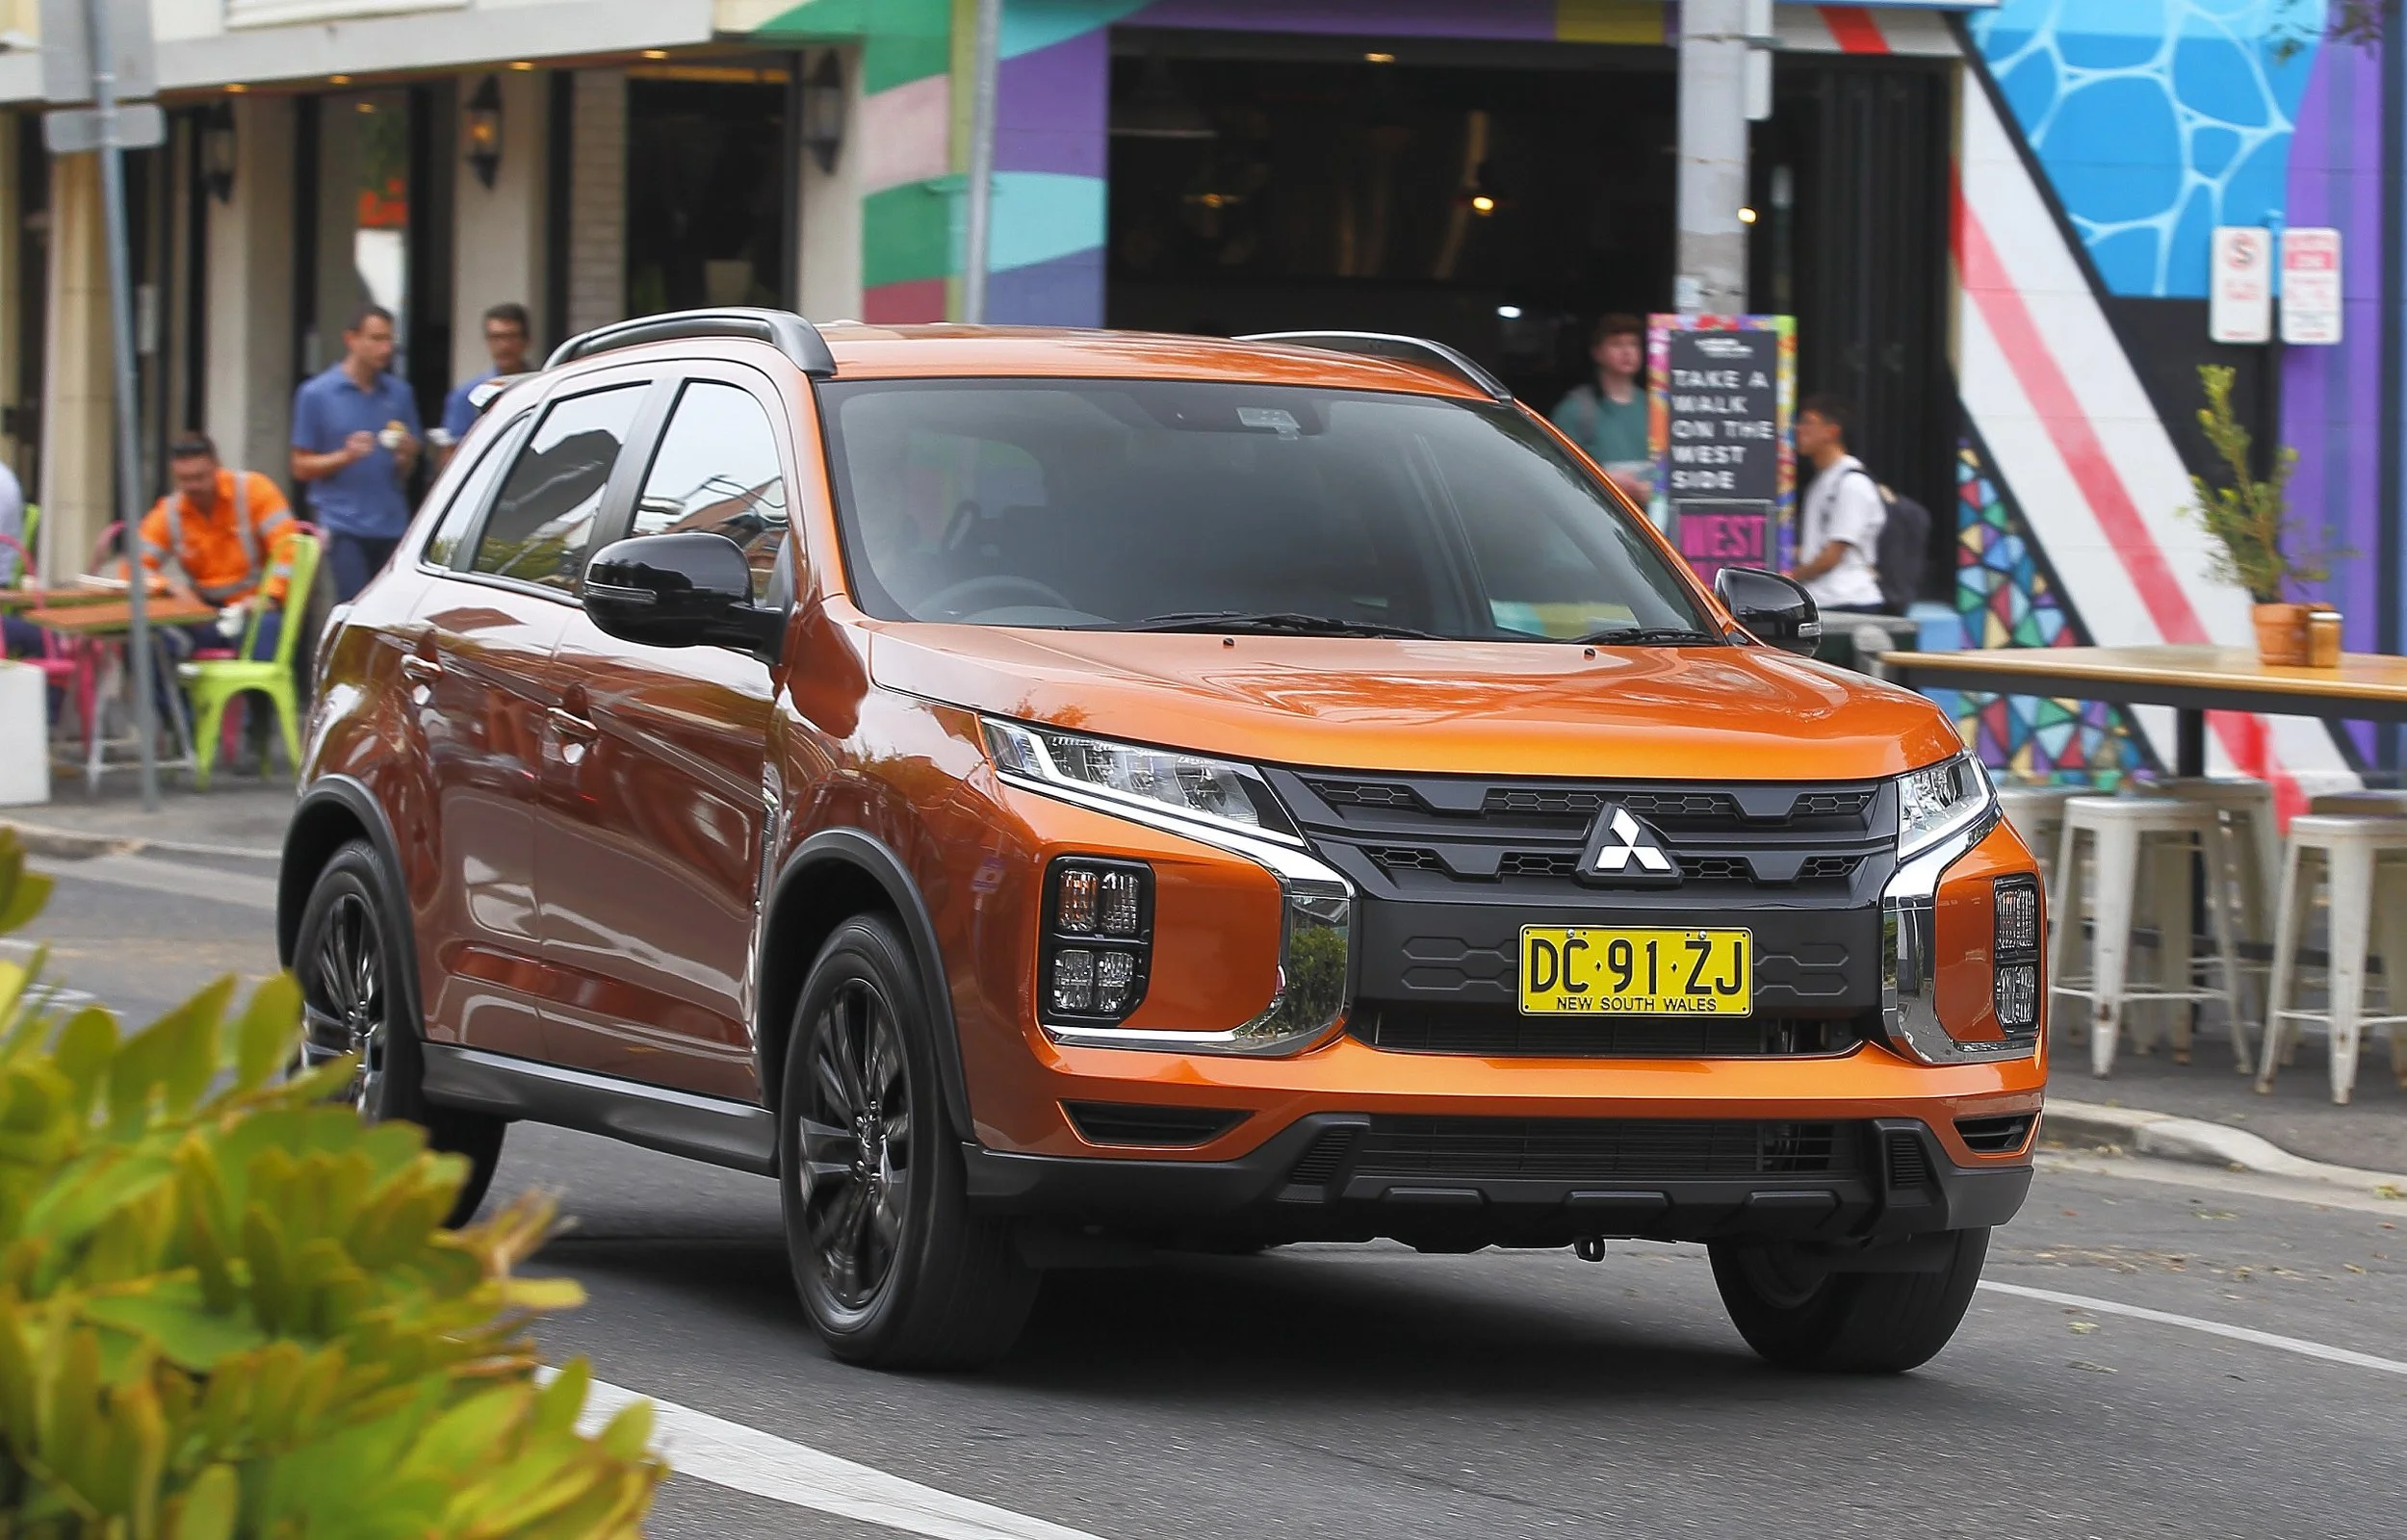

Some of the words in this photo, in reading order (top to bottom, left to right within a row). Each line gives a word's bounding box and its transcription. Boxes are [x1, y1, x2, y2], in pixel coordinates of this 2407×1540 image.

[1671, 370, 1741, 389] TAKE
[1747, 370, 1770, 388] A
[1671, 395, 1749, 415] WALK
[1670, 420, 1715, 438] ON
[1722, 420, 1774, 439] THE
[1671, 445, 1747, 464] WEST
[1670, 471, 1735, 490] SIDE
[1556, 996, 1593, 1010] NEW
[1600, 997, 1655, 1011] SOUTH
[1665, 998, 1718, 1012] WALES
